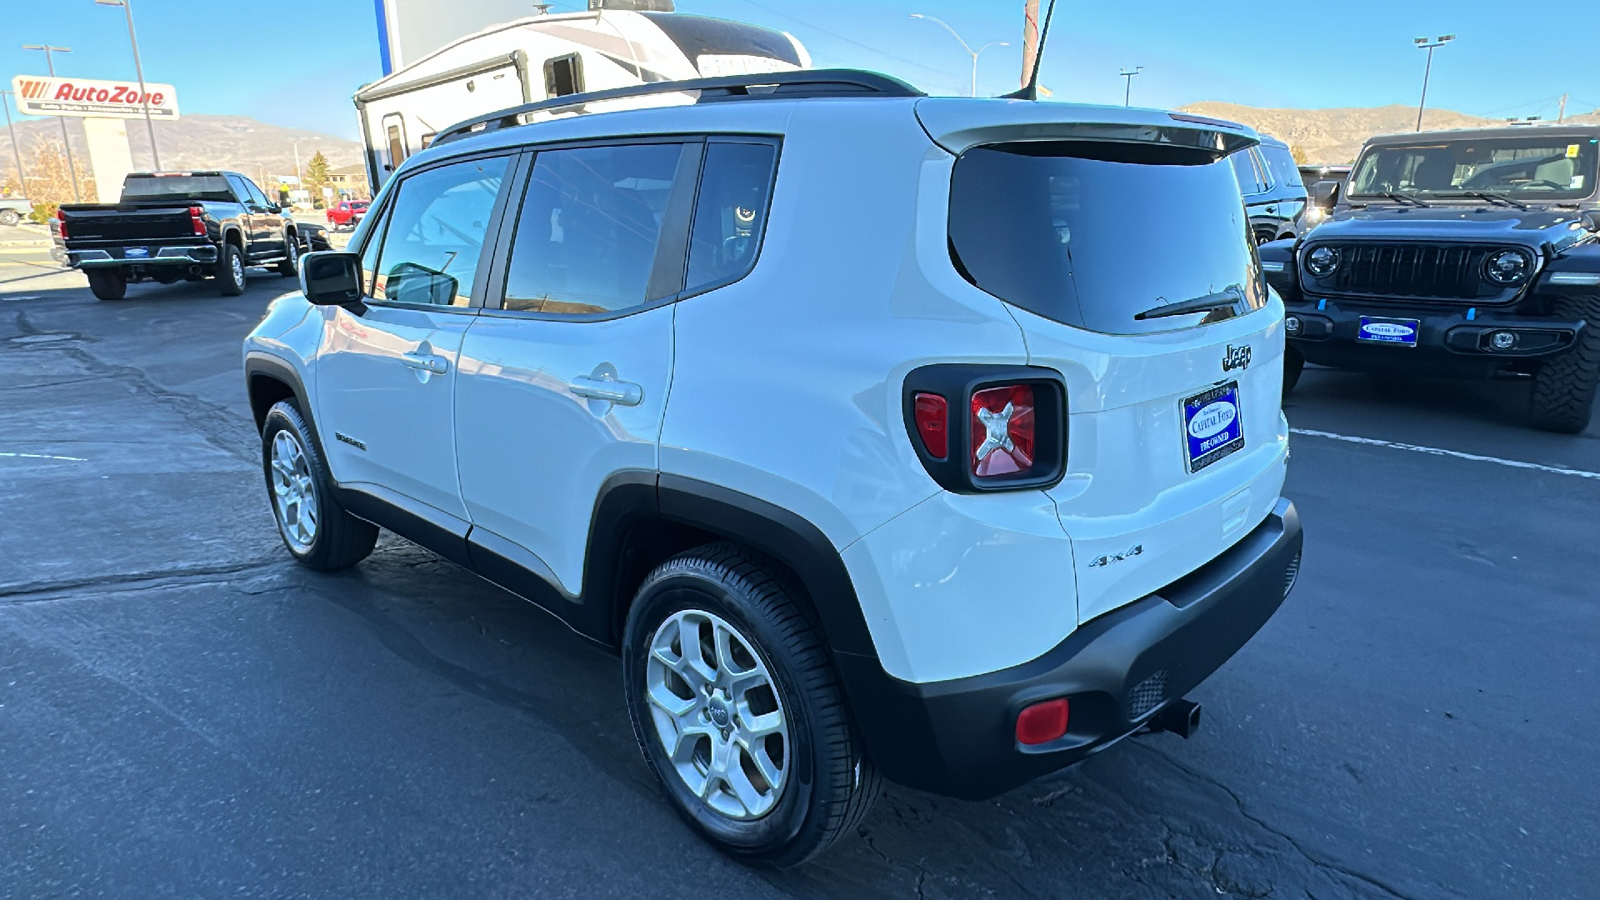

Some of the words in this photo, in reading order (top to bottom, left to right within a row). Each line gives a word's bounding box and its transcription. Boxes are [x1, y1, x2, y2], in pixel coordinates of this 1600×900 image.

[54, 83, 164, 105] AutoZone
[1222, 344, 1251, 372] Jeep
[1192, 416, 1217, 434] CAPITAL
[1217, 409, 1234, 423] FORD
[1200, 432, 1229, 452] PRE-OWNED
[1088, 545, 1142, 567] 4x4
